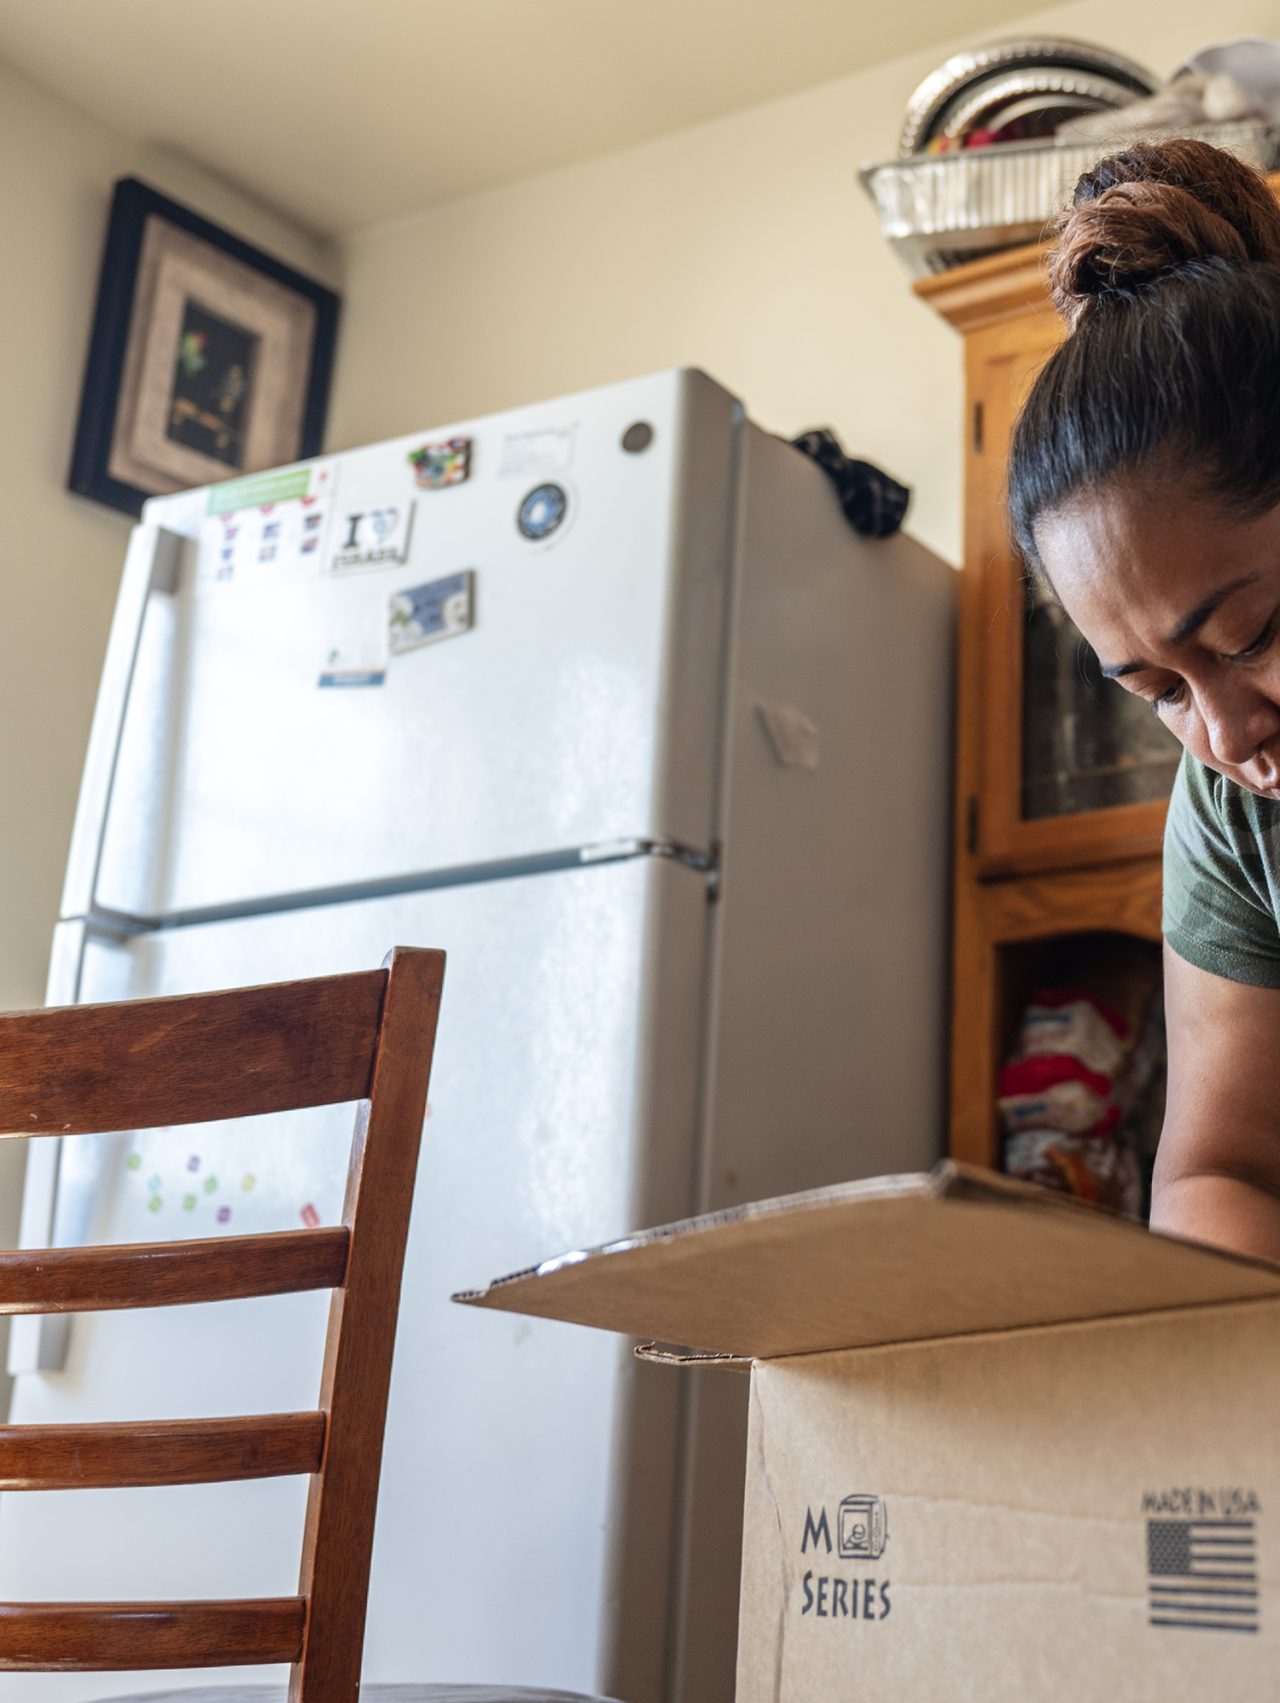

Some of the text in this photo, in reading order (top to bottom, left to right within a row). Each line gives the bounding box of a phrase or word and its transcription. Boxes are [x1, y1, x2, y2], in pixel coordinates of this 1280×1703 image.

[1140, 1486, 1262, 1514] MADE IN USA
[801, 1505, 832, 1554] M
[801, 1570, 892, 1620] SERIES
